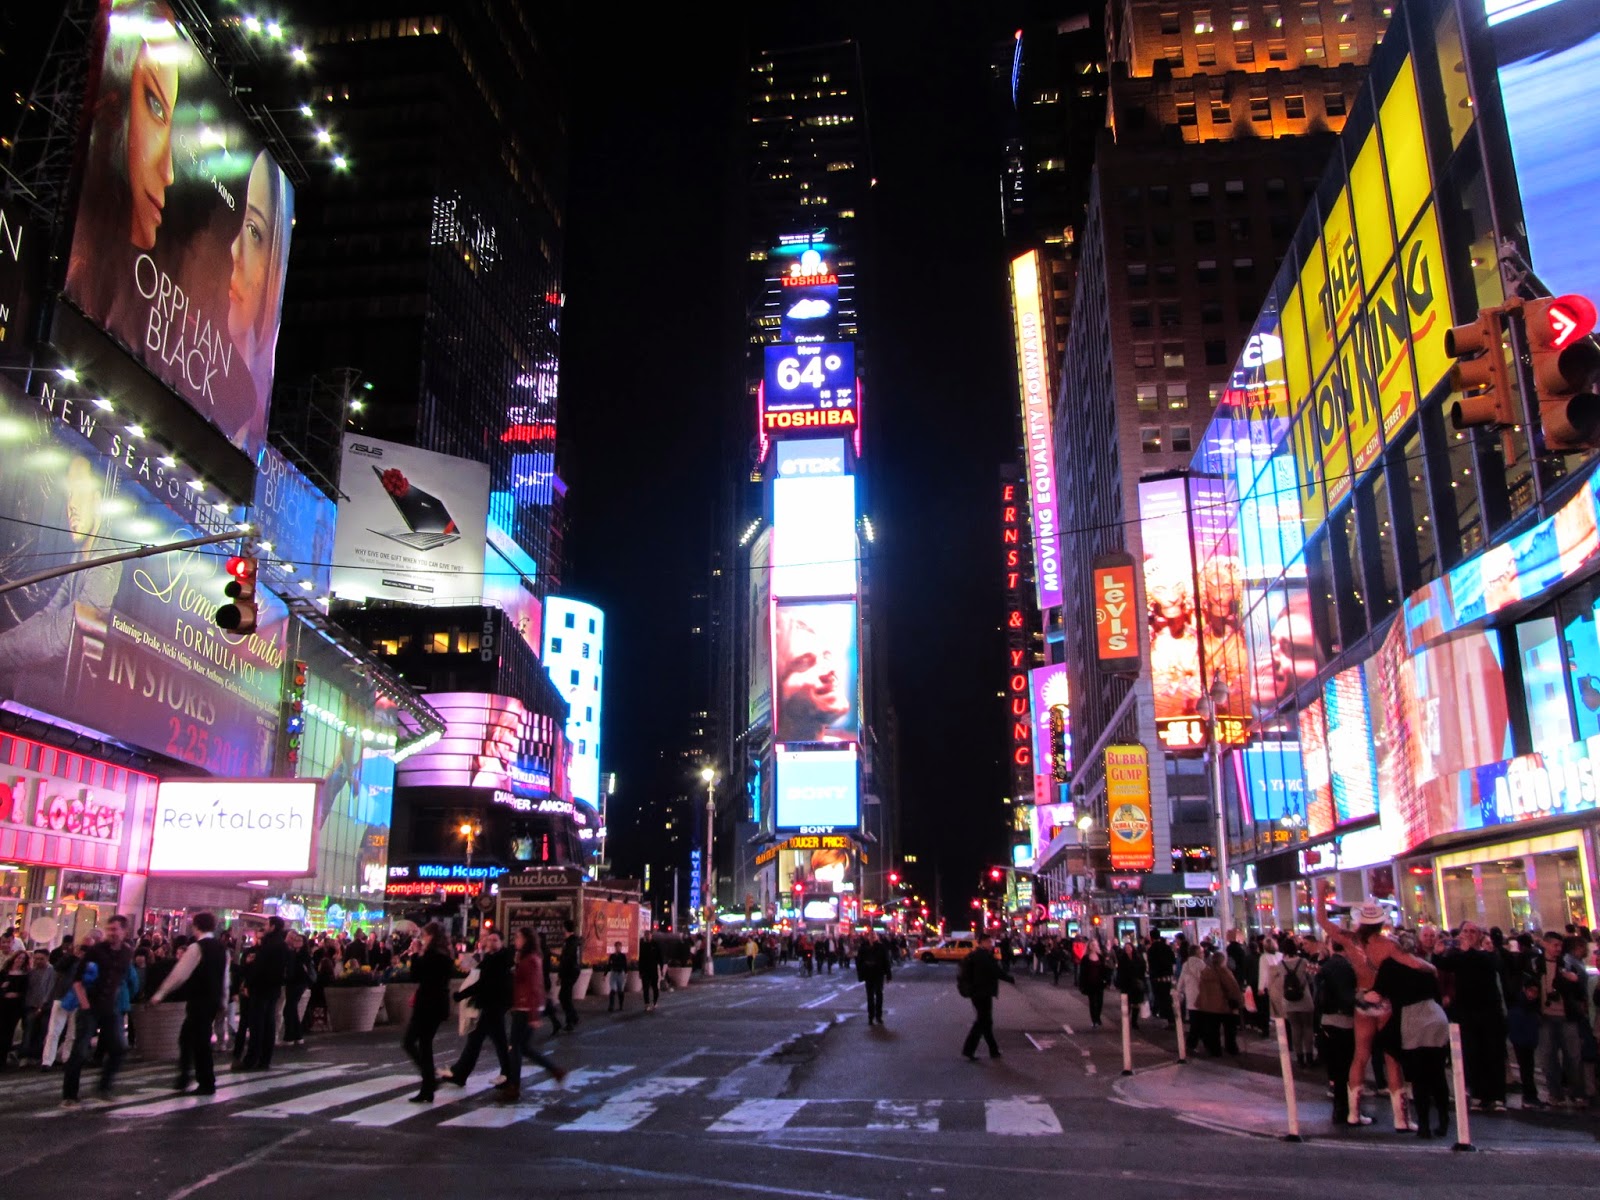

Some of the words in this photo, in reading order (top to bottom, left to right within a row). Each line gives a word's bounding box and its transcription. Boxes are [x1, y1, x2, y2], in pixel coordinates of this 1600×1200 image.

[781, 274, 837, 287] TOSHIBA
[1318, 234, 1359, 331] THE
[135, 254, 233, 377] ORPHAN
[146, 308, 219, 405] BLACK
[777, 355, 841, 390] 64°
[1022, 312, 1043, 405] FORWARD
[1297, 354, 1355, 501] LION
[1351, 239, 1433, 428] KING
[764, 409, 855, 428] TOSHIBA
[40, 382, 96, 438] NEW
[111, 434, 195, 512] SEASON
[349, 443, 383, 456] ASUS
[795, 457, 841, 474] TDK
[1028, 410, 1051, 504] EQUALITY
[1329, 468, 1351, 503] ENTRANC
[1355, 451, 1365, 469] ON
[1366, 433, 1379, 455] 45TH
[1384, 403, 1402, 435] STREET
[355, 548, 366, 556] WHY
[367, 550, 379, 558] GIVE
[380, 552, 390, 560] ONE
[391, 554, 402, 562] GIFT
[403, 556, 417, 564] WHEN
[440, 562, 450, 570] GIVE
[1003, 485, 1020, 590] ERNST
[1038, 508, 1059, 591] MOVING
[143, 631, 161, 653] Drake,
[175, 618, 236, 674] FORMULA
[481, 607, 494, 662] 1500
[1009, 611, 1023, 627] &
[107, 645, 137, 690] IN
[143, 660, 216, 725] STORES
[1011, 650, 1030, 765] YOUNG
[1107, 752, 1144, 765] BUBBA
[1111, 767, 1142, 780] GUMP
[35, 777, 125, 840] Locker
[787, 786, 848, 800] SONY
[800, 825, 834, 834] SONY
[389, 866, 409, 877] EWS
[419, 865, 450, 878] White
[508, 871, 568, 886] nuchas
